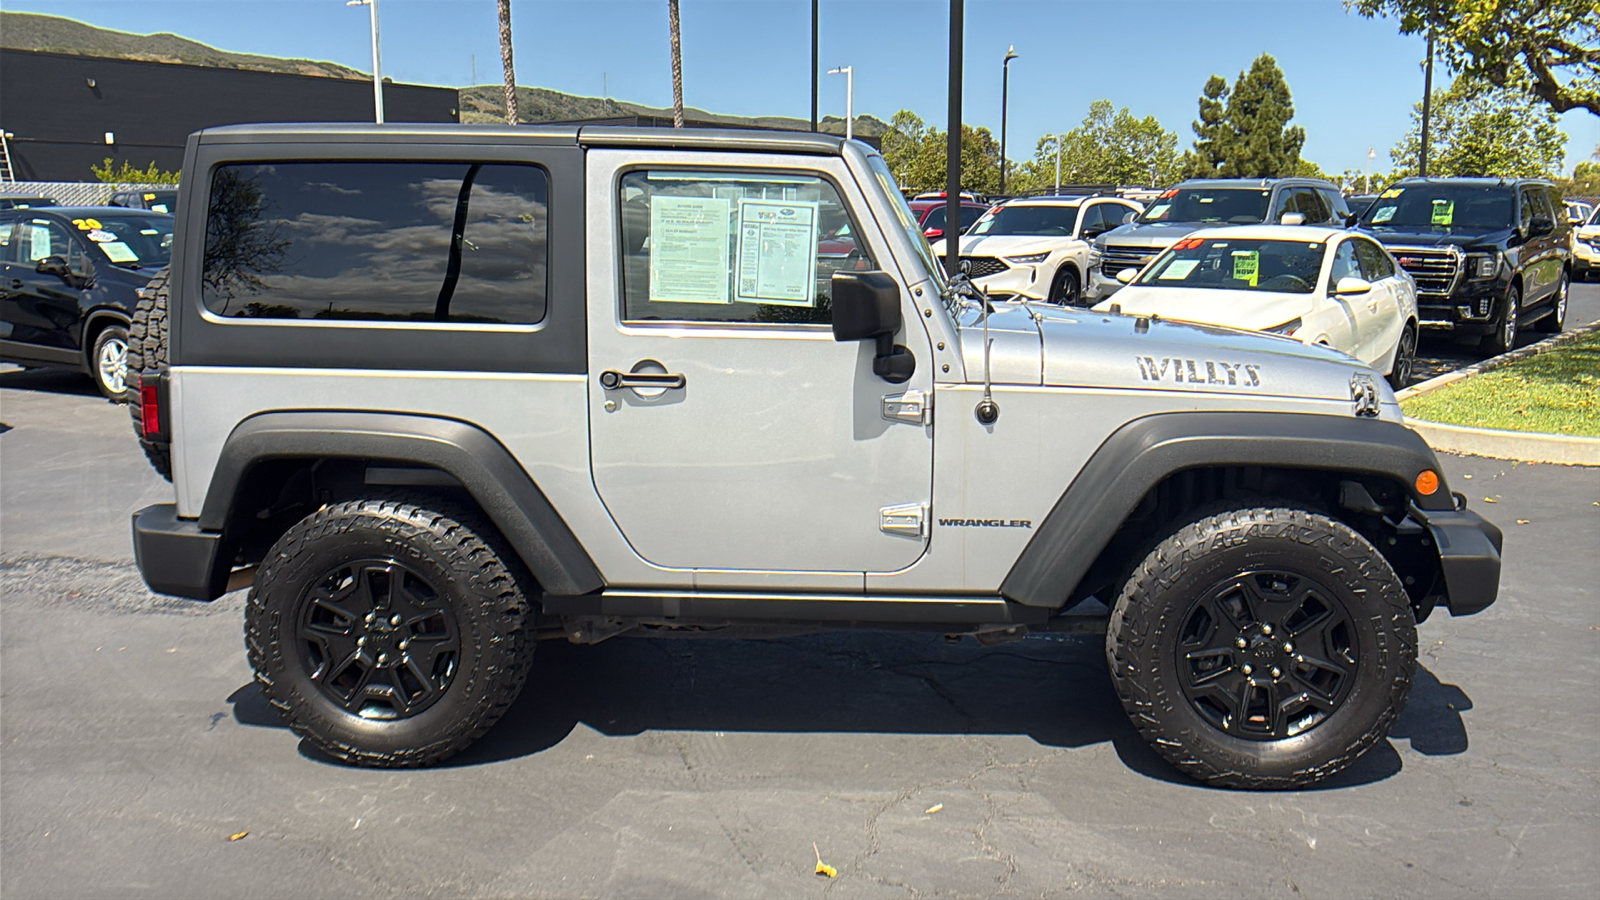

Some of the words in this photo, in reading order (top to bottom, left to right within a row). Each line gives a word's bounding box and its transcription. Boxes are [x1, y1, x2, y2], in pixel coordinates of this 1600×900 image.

[72, 218, 103, 231] 20
[1135, 356, 1261, 387] WILLYS
[938, 518, 1032, 528] WRANGLER
[1318, 555, 1369, 605] BAJA
